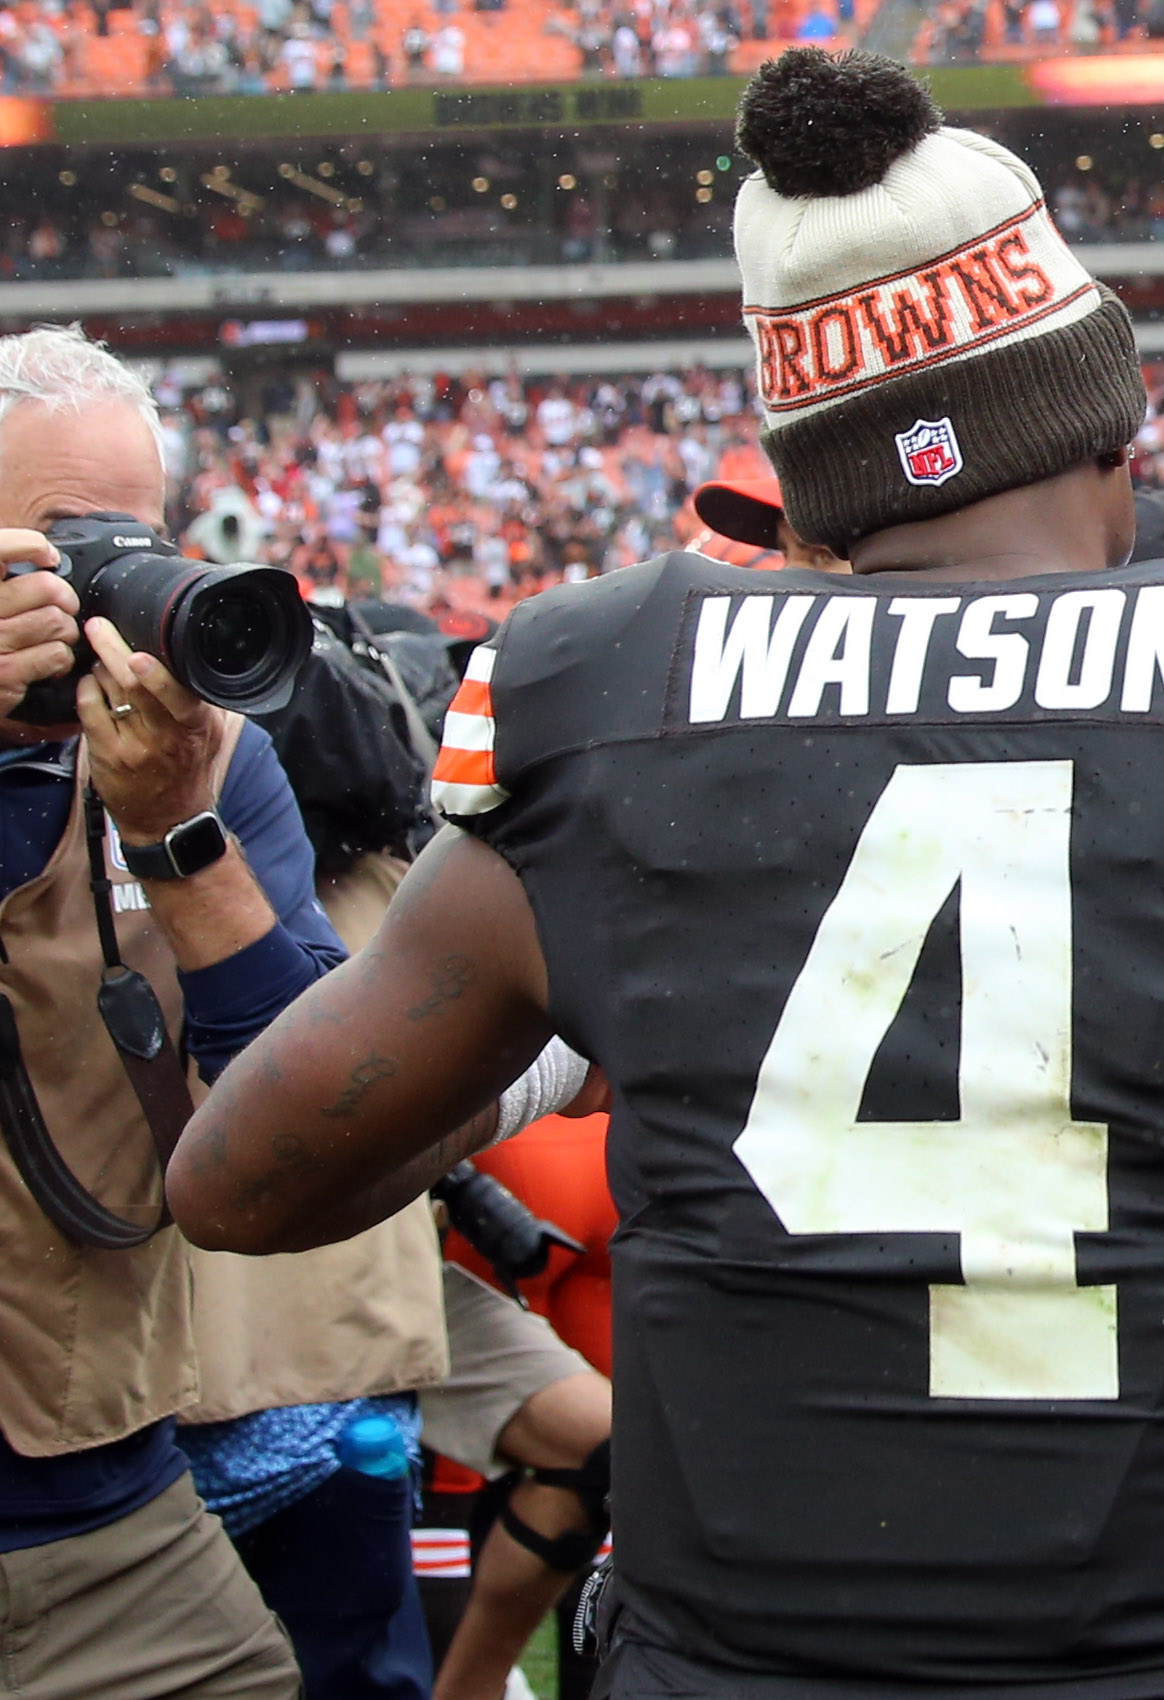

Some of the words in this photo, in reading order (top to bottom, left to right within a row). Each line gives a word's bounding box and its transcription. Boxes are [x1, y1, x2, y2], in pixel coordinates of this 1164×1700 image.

[908, 445, 955, 477] NFL
[113, 535, 153, 548] Canon
[731, 759, 1120, 1400] 4
